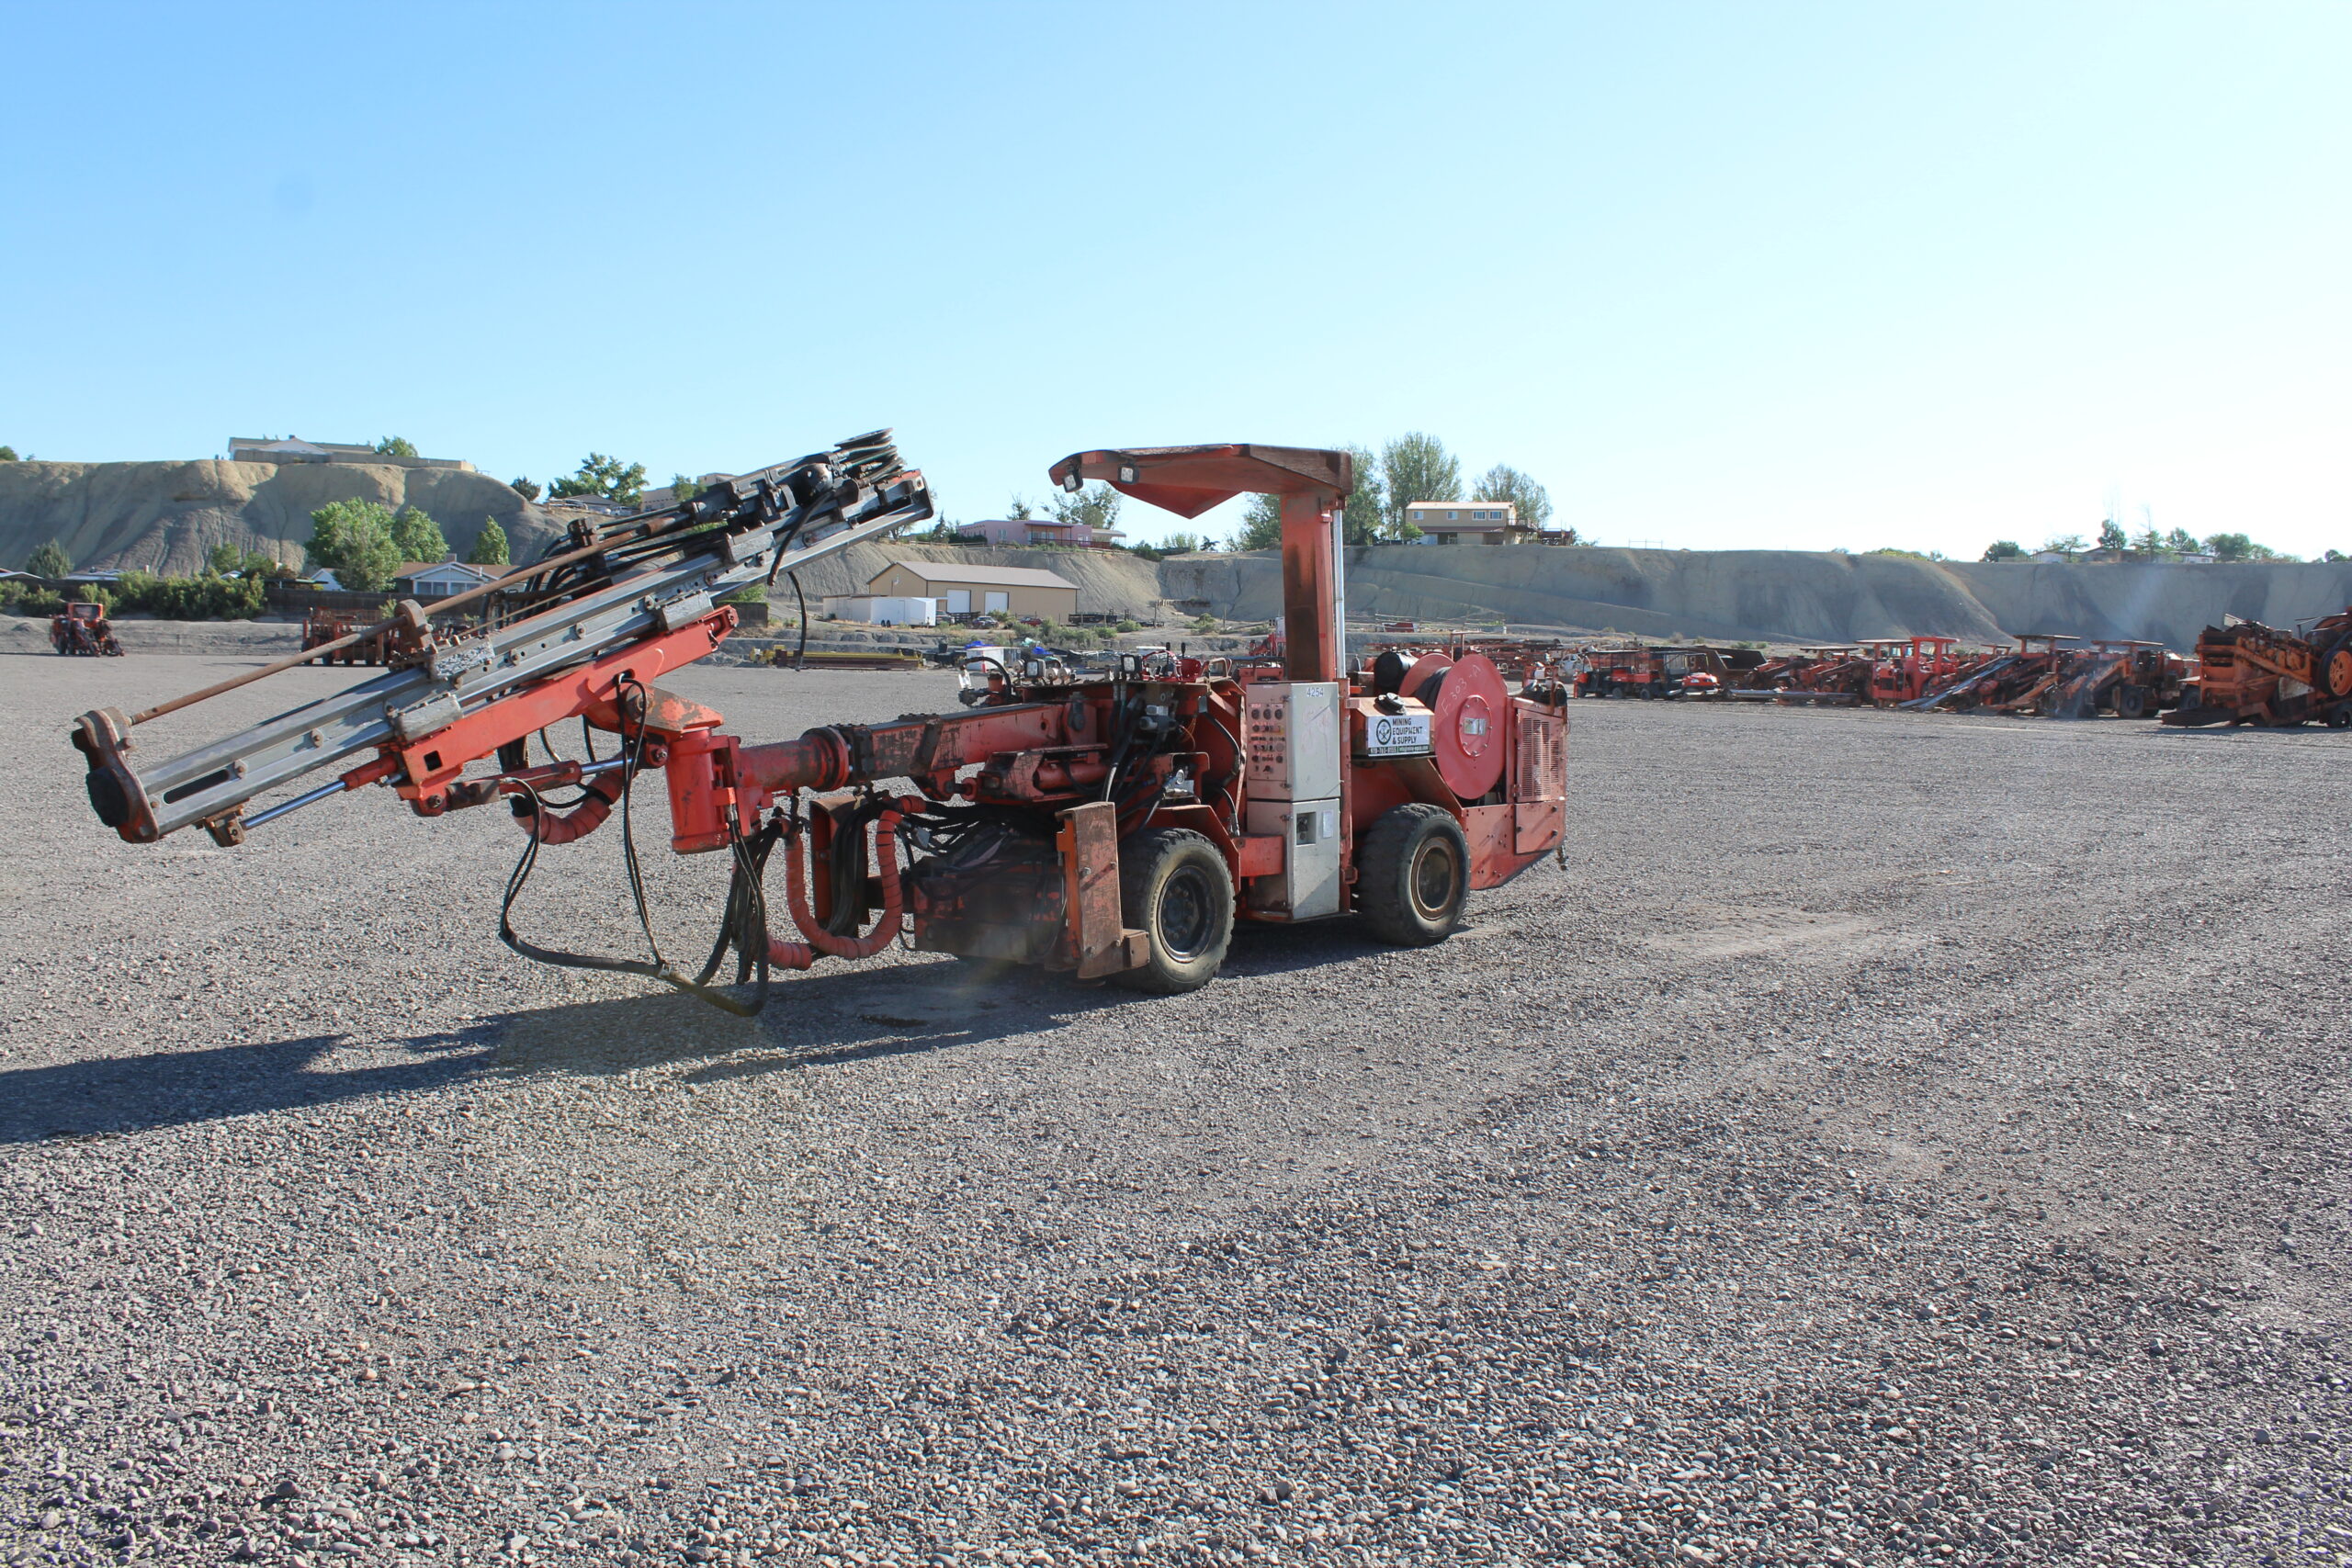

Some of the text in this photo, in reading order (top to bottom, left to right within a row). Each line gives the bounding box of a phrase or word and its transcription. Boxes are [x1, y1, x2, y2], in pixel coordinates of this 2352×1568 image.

[1306, 687, 1324, 696] 4254
[1392, 727, 1422, 735] EQUIPMENT
[1397, 736, 1417, 744] SUPPLY
